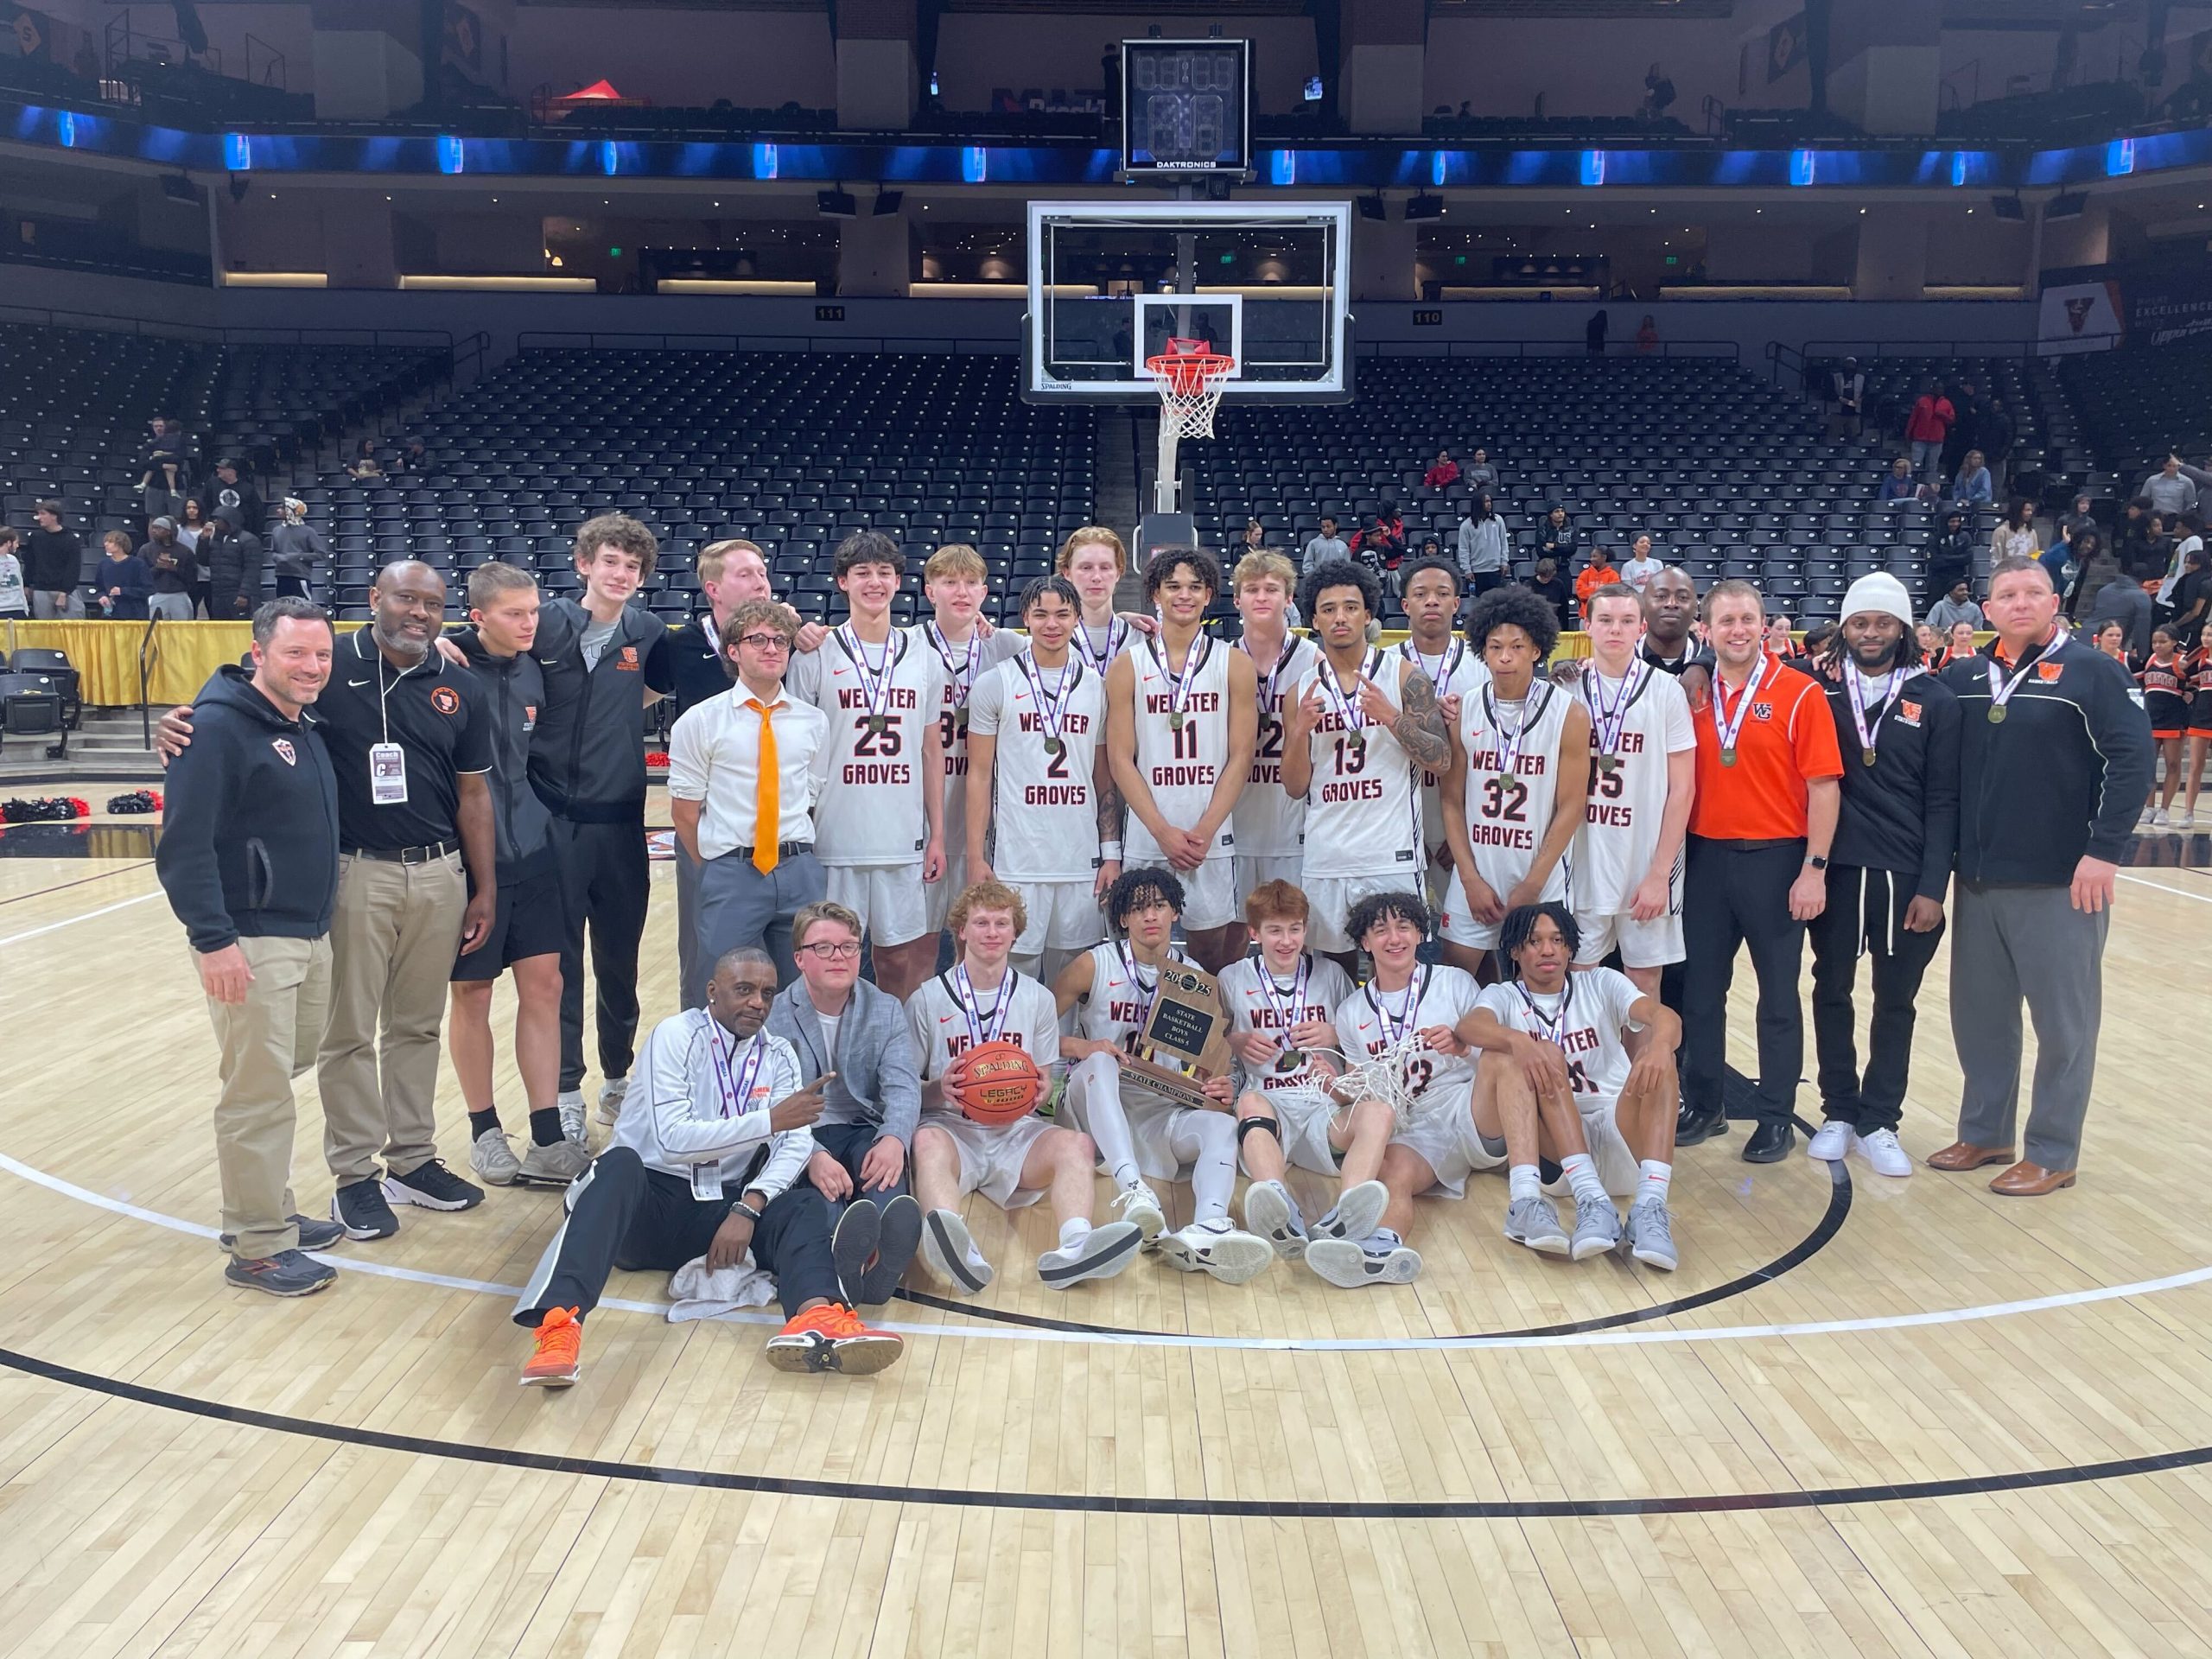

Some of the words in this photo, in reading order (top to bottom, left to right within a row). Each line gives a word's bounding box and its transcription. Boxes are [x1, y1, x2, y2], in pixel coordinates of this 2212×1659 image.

[817, 308, 843, 319] 111
[1414, 312, 1440, 324] 110
[838, 689, 916, 709] WETER
[1019, 712, 1090, 735] WETER
[855, 715, 901, 757] 25
[1172, 719, 1198, 760] 11
[1255, 720, 1283, 759] 2
[1047, 739, 1069, 779] 2
[1334, 737, 1367, 776] 13
[1472, 750, 1546, 775] WETER
[376, 763, 386, 777] C
[843, 764, 910, 785] GROVES
[1153, 766, 1214, 786] GROVES
[1025, 785, 1086, 805] GROVES
[1322, 779, 1382, 804] GROVES
[1482, 779, 1529, 823] 32
[1586, 804, 1632, 827] OVES
[1472, 823, 1533, 849] GROVES
[1164, 970, 1179, 982] 20
[1198, 983, 1211, 995] 25
[1162, 1013, 1204, 1033] BASKETBALL
[1176, 1008, 1196, 1021] STATE
[1249, 1005, 1326, 1028] WESER
[1165, 1032, 1185, 1045] CLASS
[1171, 1026, 1189, 1037] BOYS
[974, 1059, 1030, 1079] SPALDING
[981, 1084, 1027, 1097] LEGACY
[1130, 1072, 1151, 1086] STATE
[1152, 1081, 1195, 1103] CHAMPIONS
[1263, 1073, 1310, 1090] GROV
